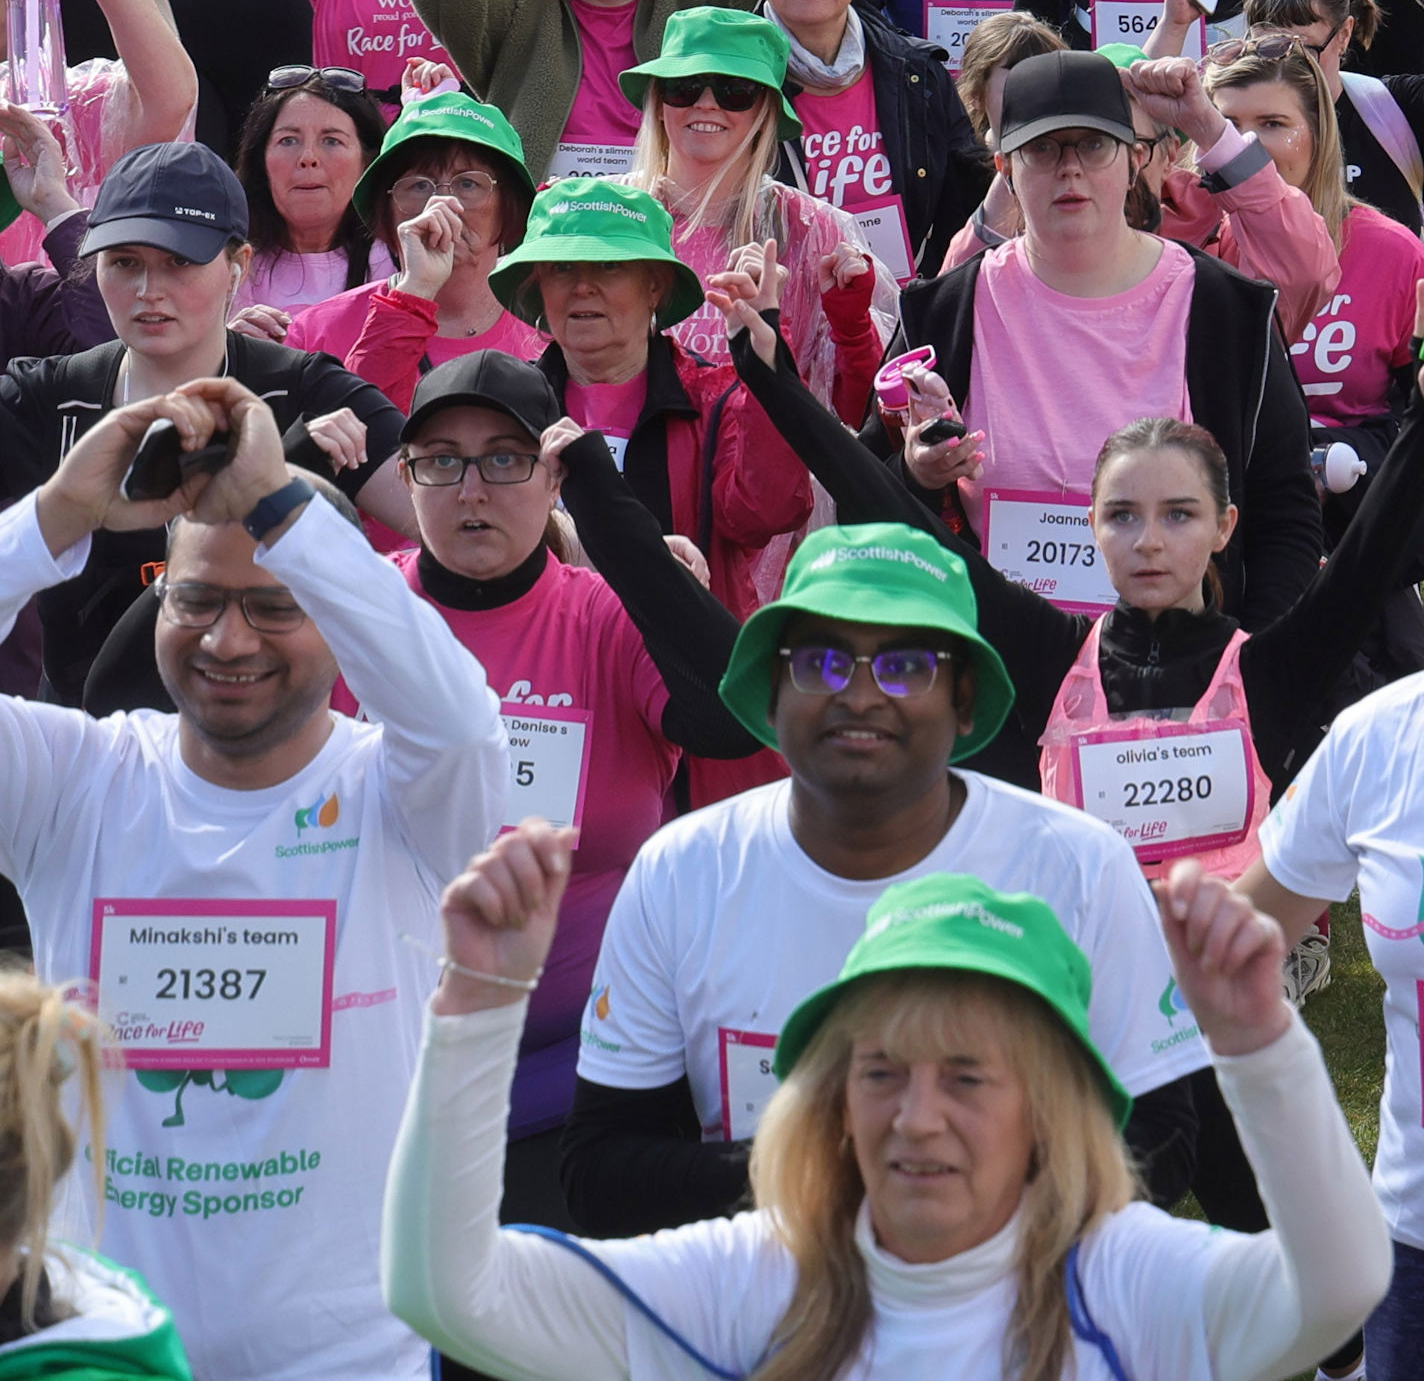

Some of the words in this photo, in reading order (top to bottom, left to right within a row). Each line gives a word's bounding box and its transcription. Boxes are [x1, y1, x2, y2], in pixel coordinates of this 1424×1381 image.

[941, 8, 980, 17] Deborah's
[347, 24, 394, 58] Race
[396, 22, 424, 58] for
[421, 107, 495, 130] ScottishPower
[559, 143, 601, 155] Deborah's
[846, 124, 882, 154] for
[577, 156, 601, 166] world
[604, 158, 628, 167] team
[570, 200, 647, 224] ScottishPower
[1039, 511, 1090, 527] Joanne
[837, 546, 948, 583] ScottishPower
[1027, 539, 1096, 567] 20173
[1033, 577, 1057, 593] Life
[511, 719, 558, 734] Denise
[1116, 746, 1170, 764] olivia's
[1174, 744, 1212, 758] team
[1123, 775, 1212, 808] 22280
[1140, 820, 1167, 838] Life
[274, 834, 360, 858] ScottishPower
[890, 902, 1024, 939] ScottishPower
[129, 925, 237, 946] Minakshi's
[241, 928, 299, 945] team
[155, 968, 267, 1000] 21387
[144, 1023, 166, 1040] for
[167, 1019, 204, 1040] Life
[166, 1145, 321, 1183] Renewable
[105, 1182, 178, 1219] Energy
[182, 1181, 305, 1220] Sponsor
